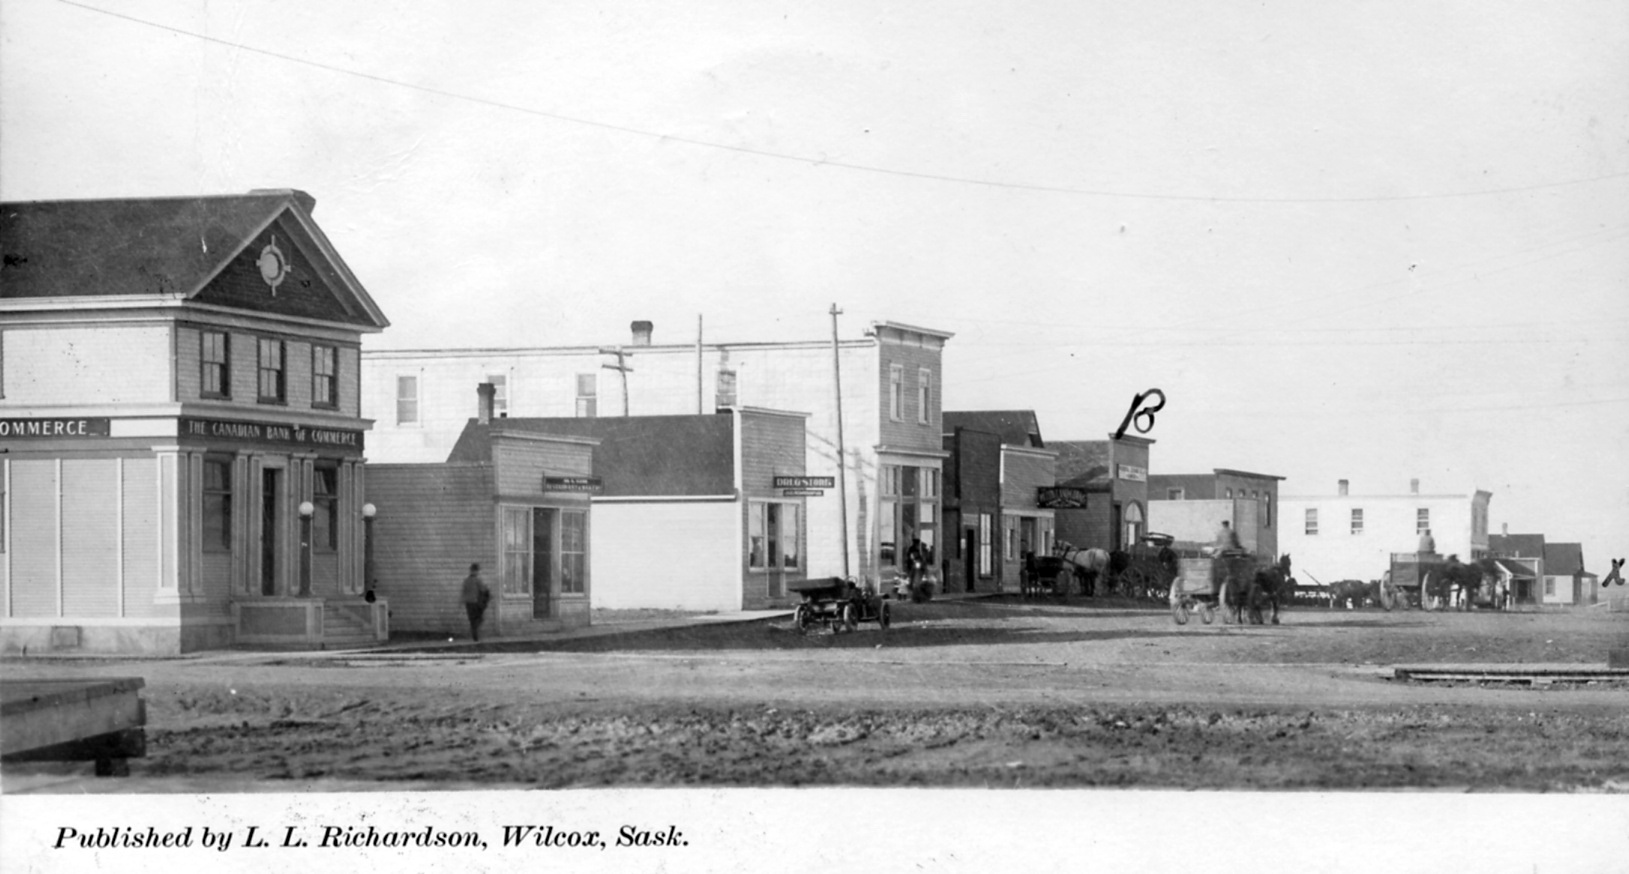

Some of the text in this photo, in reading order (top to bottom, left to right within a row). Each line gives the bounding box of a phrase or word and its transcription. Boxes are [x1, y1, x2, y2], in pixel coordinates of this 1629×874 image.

[189, 420, 356, 446] THE CANADIAN BANK OF COMMERCE
